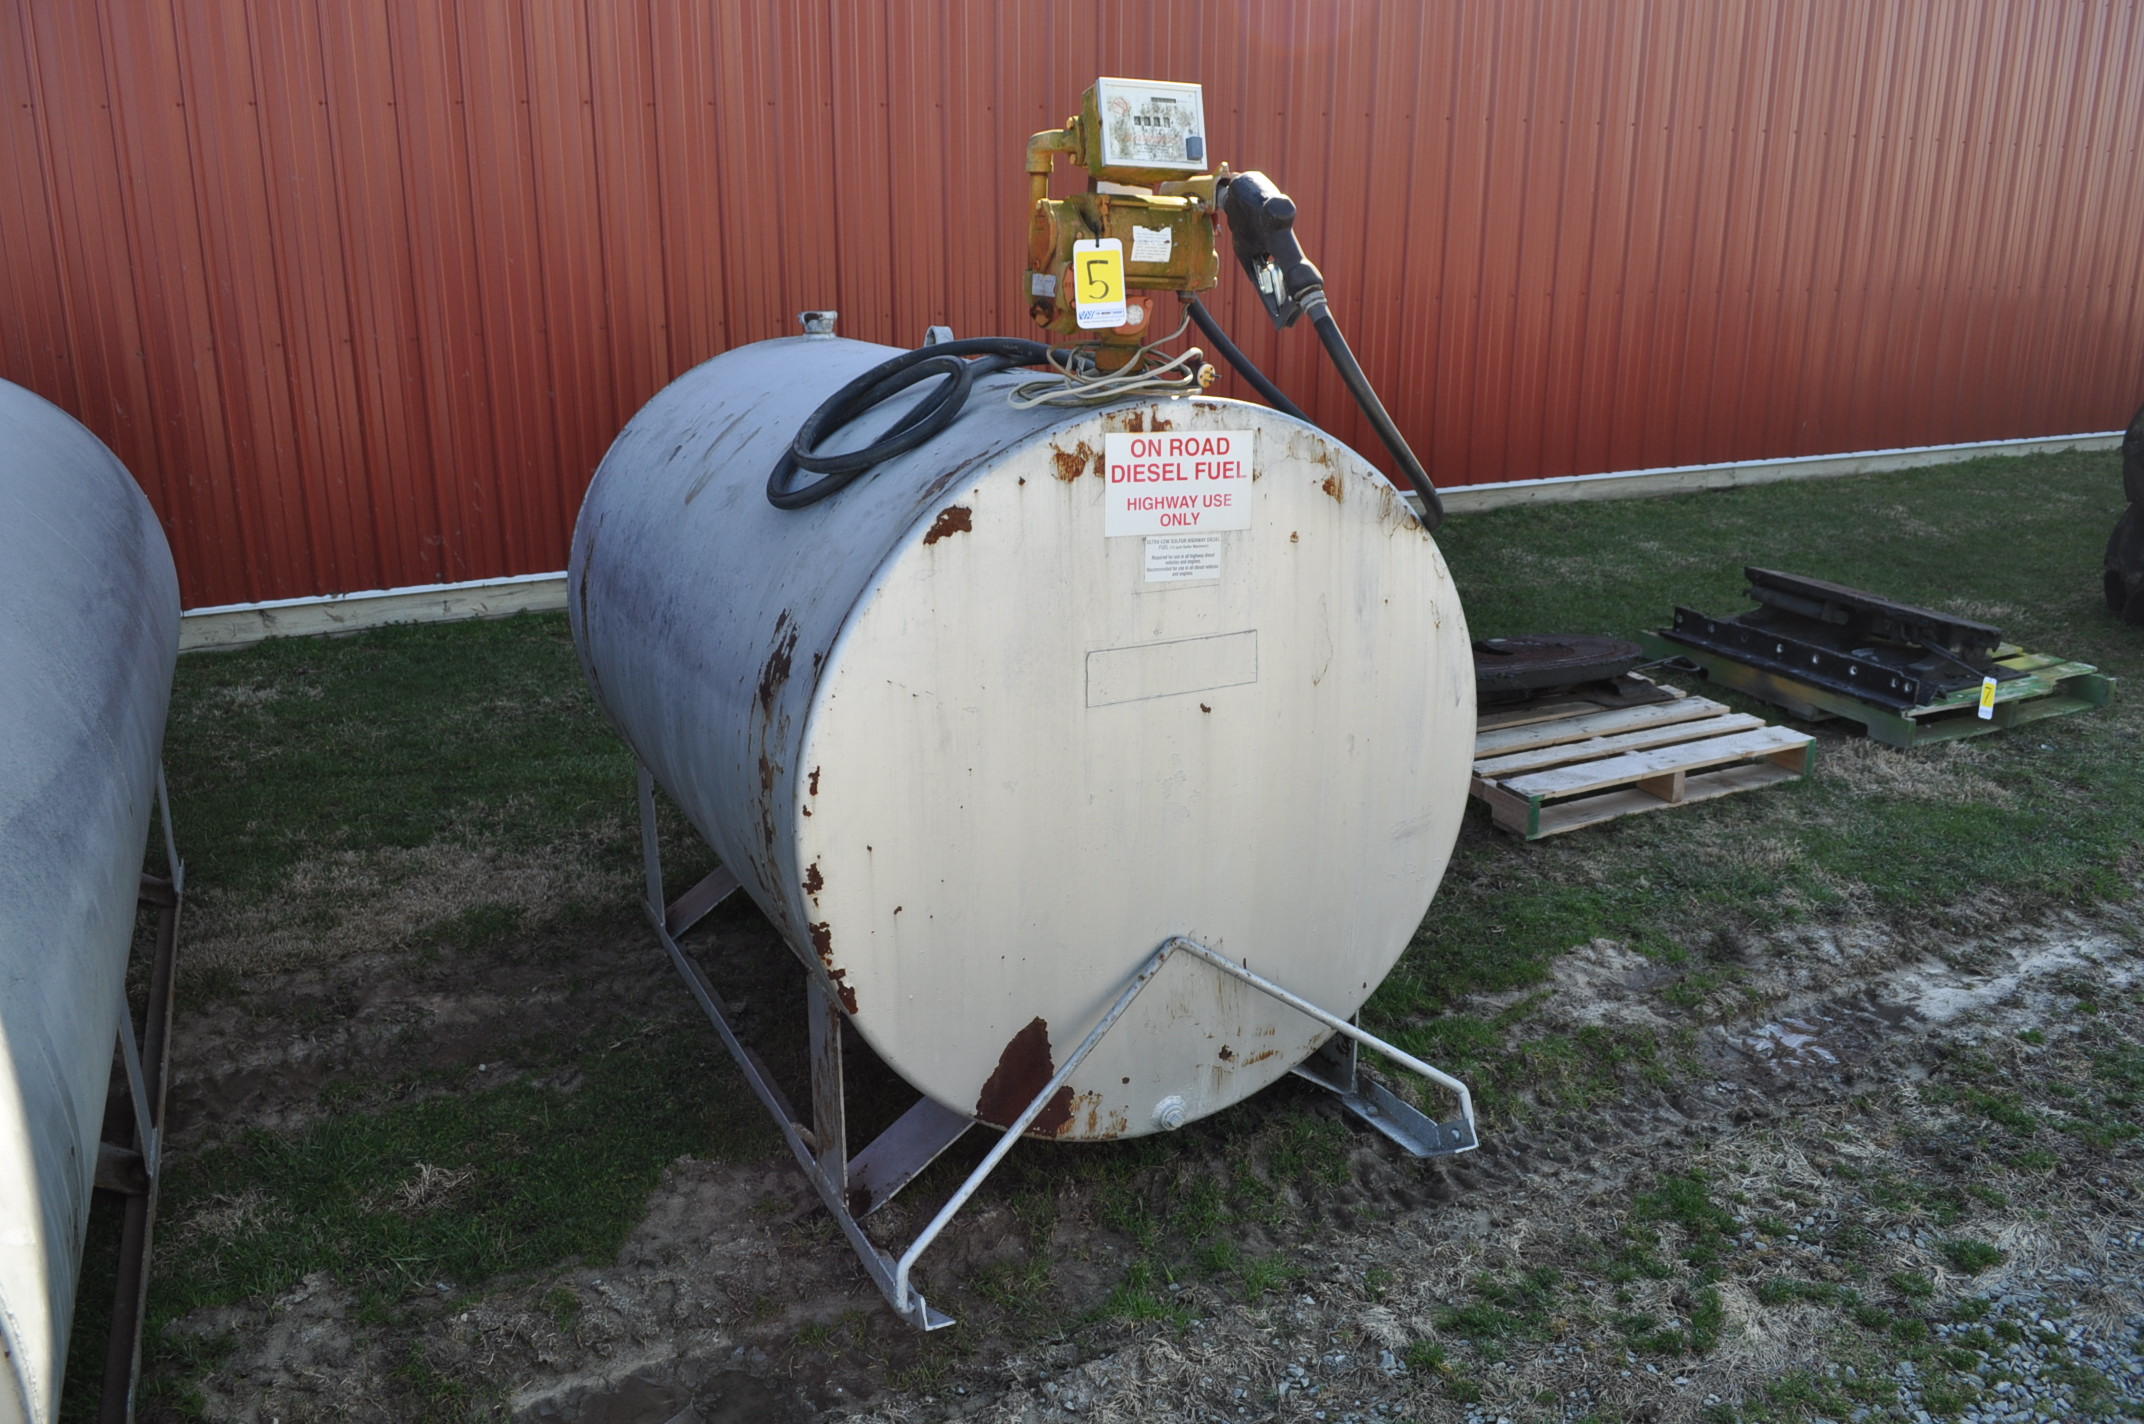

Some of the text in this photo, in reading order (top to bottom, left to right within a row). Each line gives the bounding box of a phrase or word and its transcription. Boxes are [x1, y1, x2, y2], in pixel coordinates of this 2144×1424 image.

[1086, 260, 1109, 299] 5
[1131, 438, 1230, 457] ON ROAD
[1111, 461, 1247, 483] DIESEL FUEL
[1127, 494, 1232, 510] HIGHWAY USE
[1160, 512, 1200, 526] ONLY
[1984, 686, 1992, 703] 7
